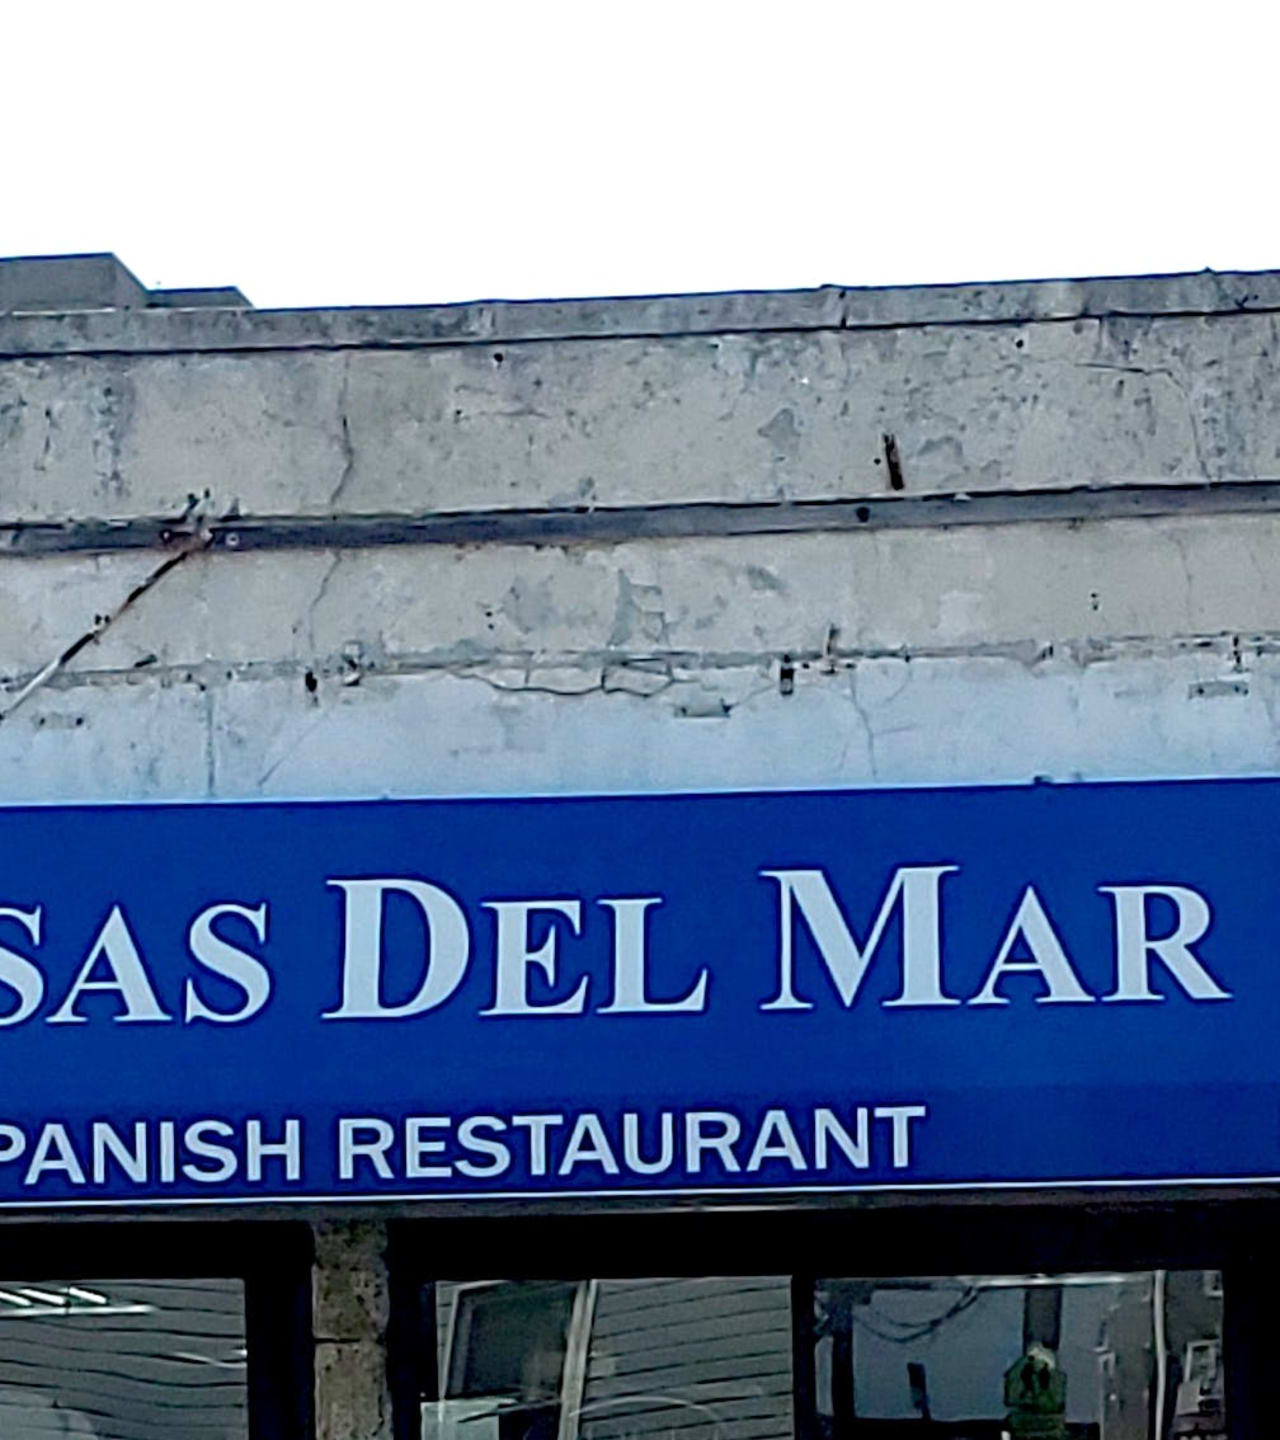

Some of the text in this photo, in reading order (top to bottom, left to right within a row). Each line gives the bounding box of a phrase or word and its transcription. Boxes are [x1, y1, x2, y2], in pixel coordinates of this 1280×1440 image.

[323, 878, 707, 1019] DEL
[761, 866, 1230, 1011] MAR
[338, 1105, 926, 1181] RESTAURANT
